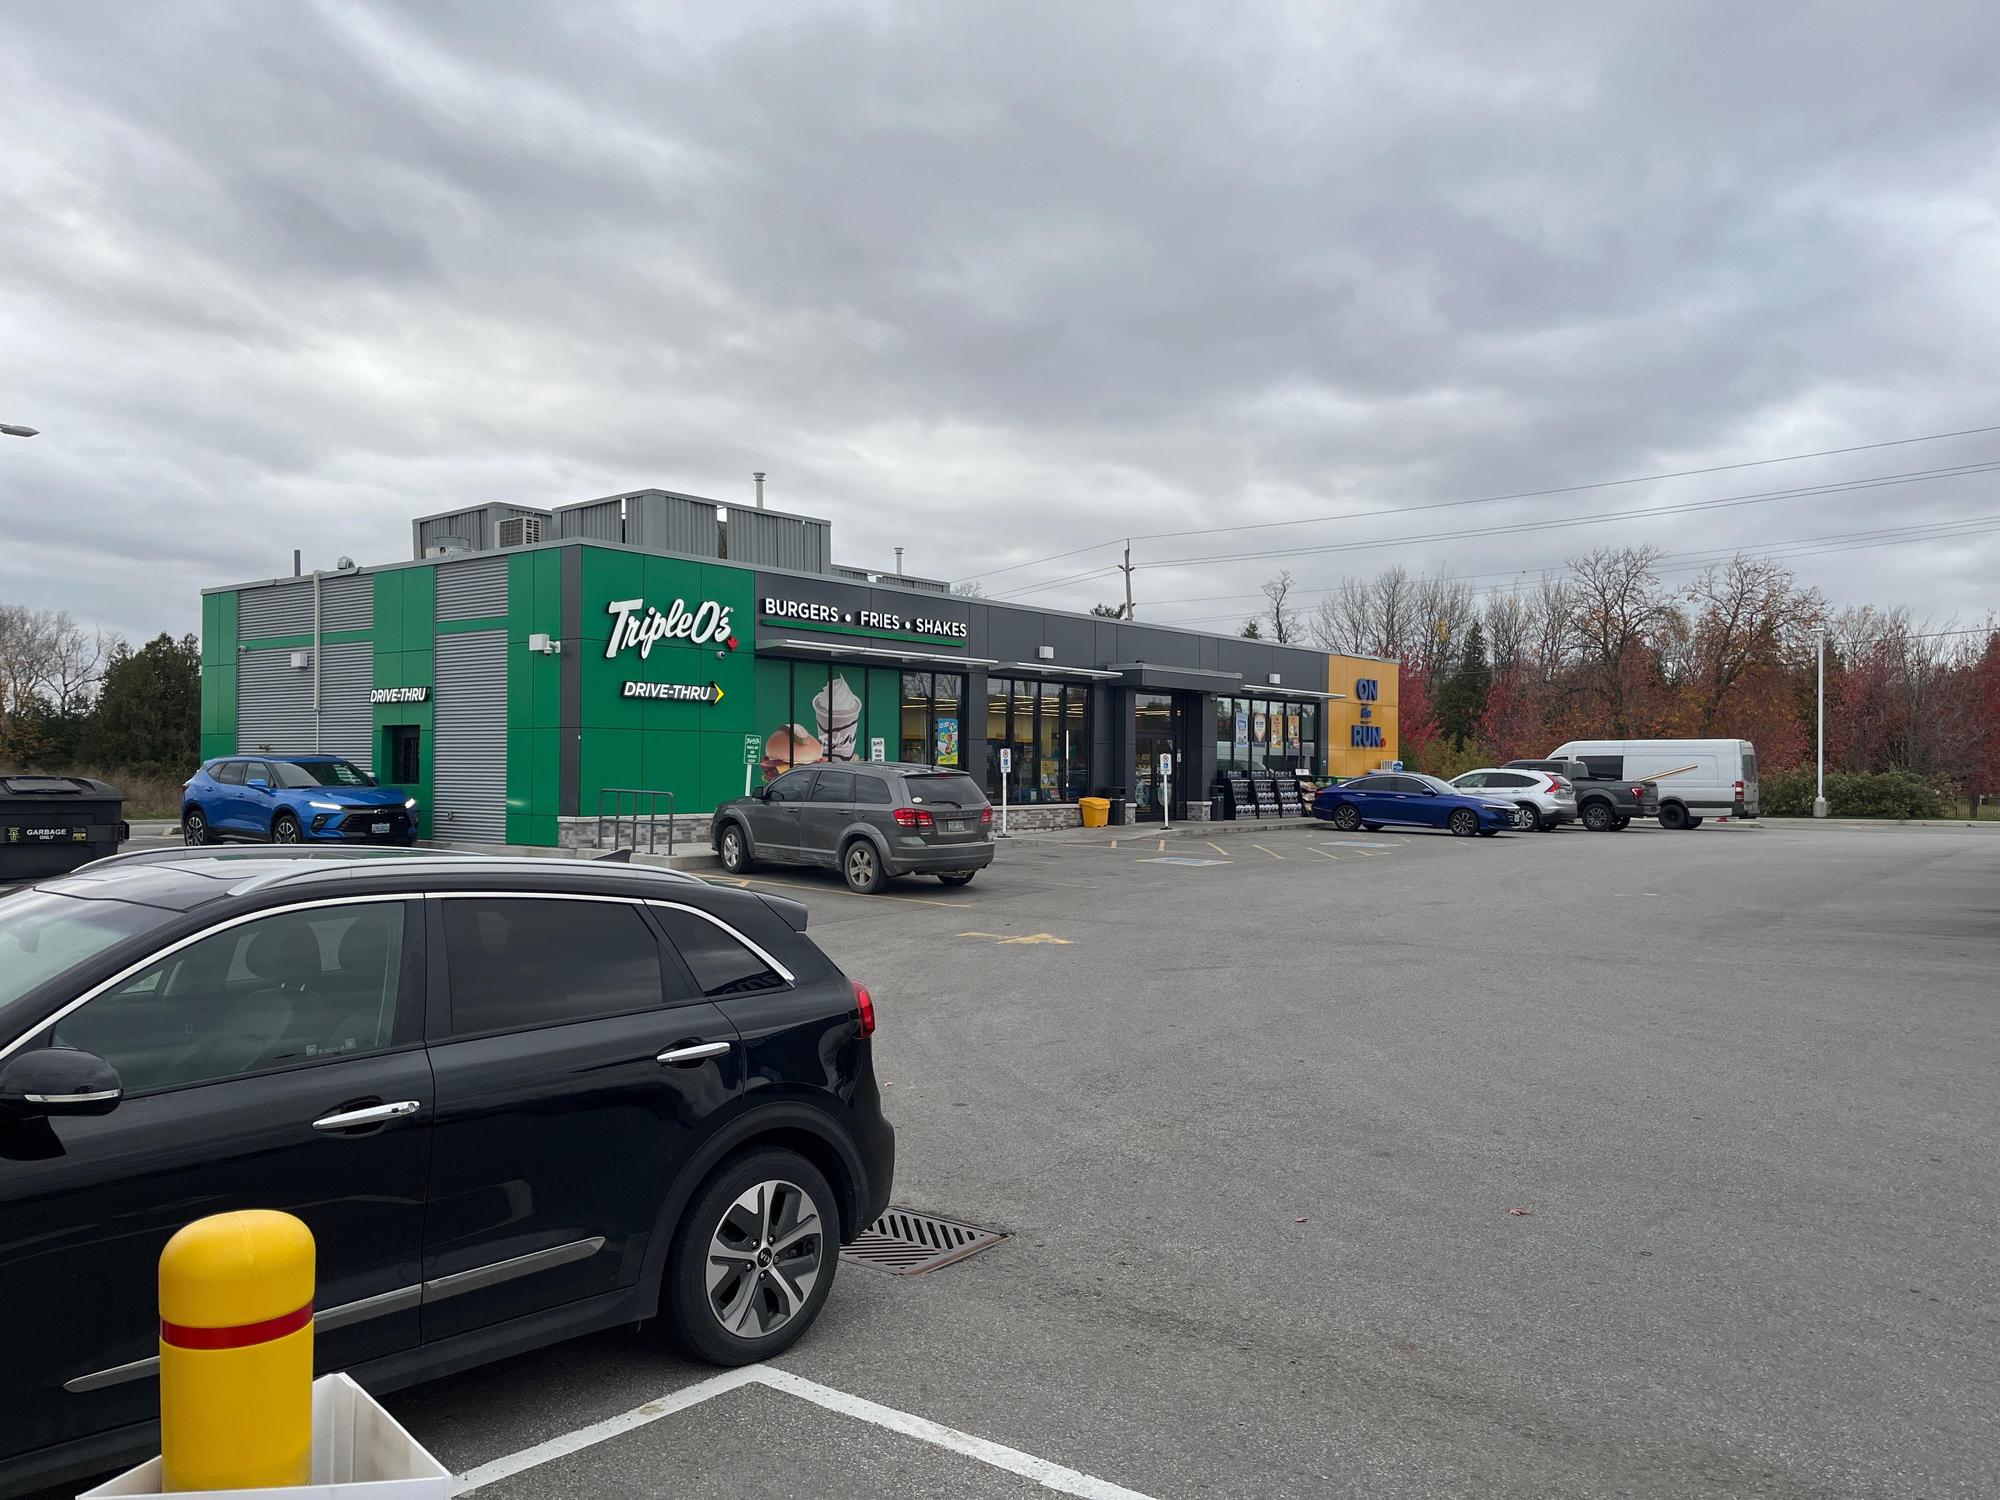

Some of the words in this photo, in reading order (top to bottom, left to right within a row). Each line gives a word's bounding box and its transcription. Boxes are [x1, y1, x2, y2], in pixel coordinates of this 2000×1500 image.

[765, 597, 838, 622] BURGERS
[860, 611, 900, 630] FRIES
[916, 618, 967, 638] SHAKES
[370, 687, 426, 703] DRIVE-THRU
[624, 682, 710, 701] DRIVE-THRU
[1356, 678, 1378, 701] ON
[1352, 725, 1381, 747] RUN
[26, 828, 67, 836] GARBAGE
